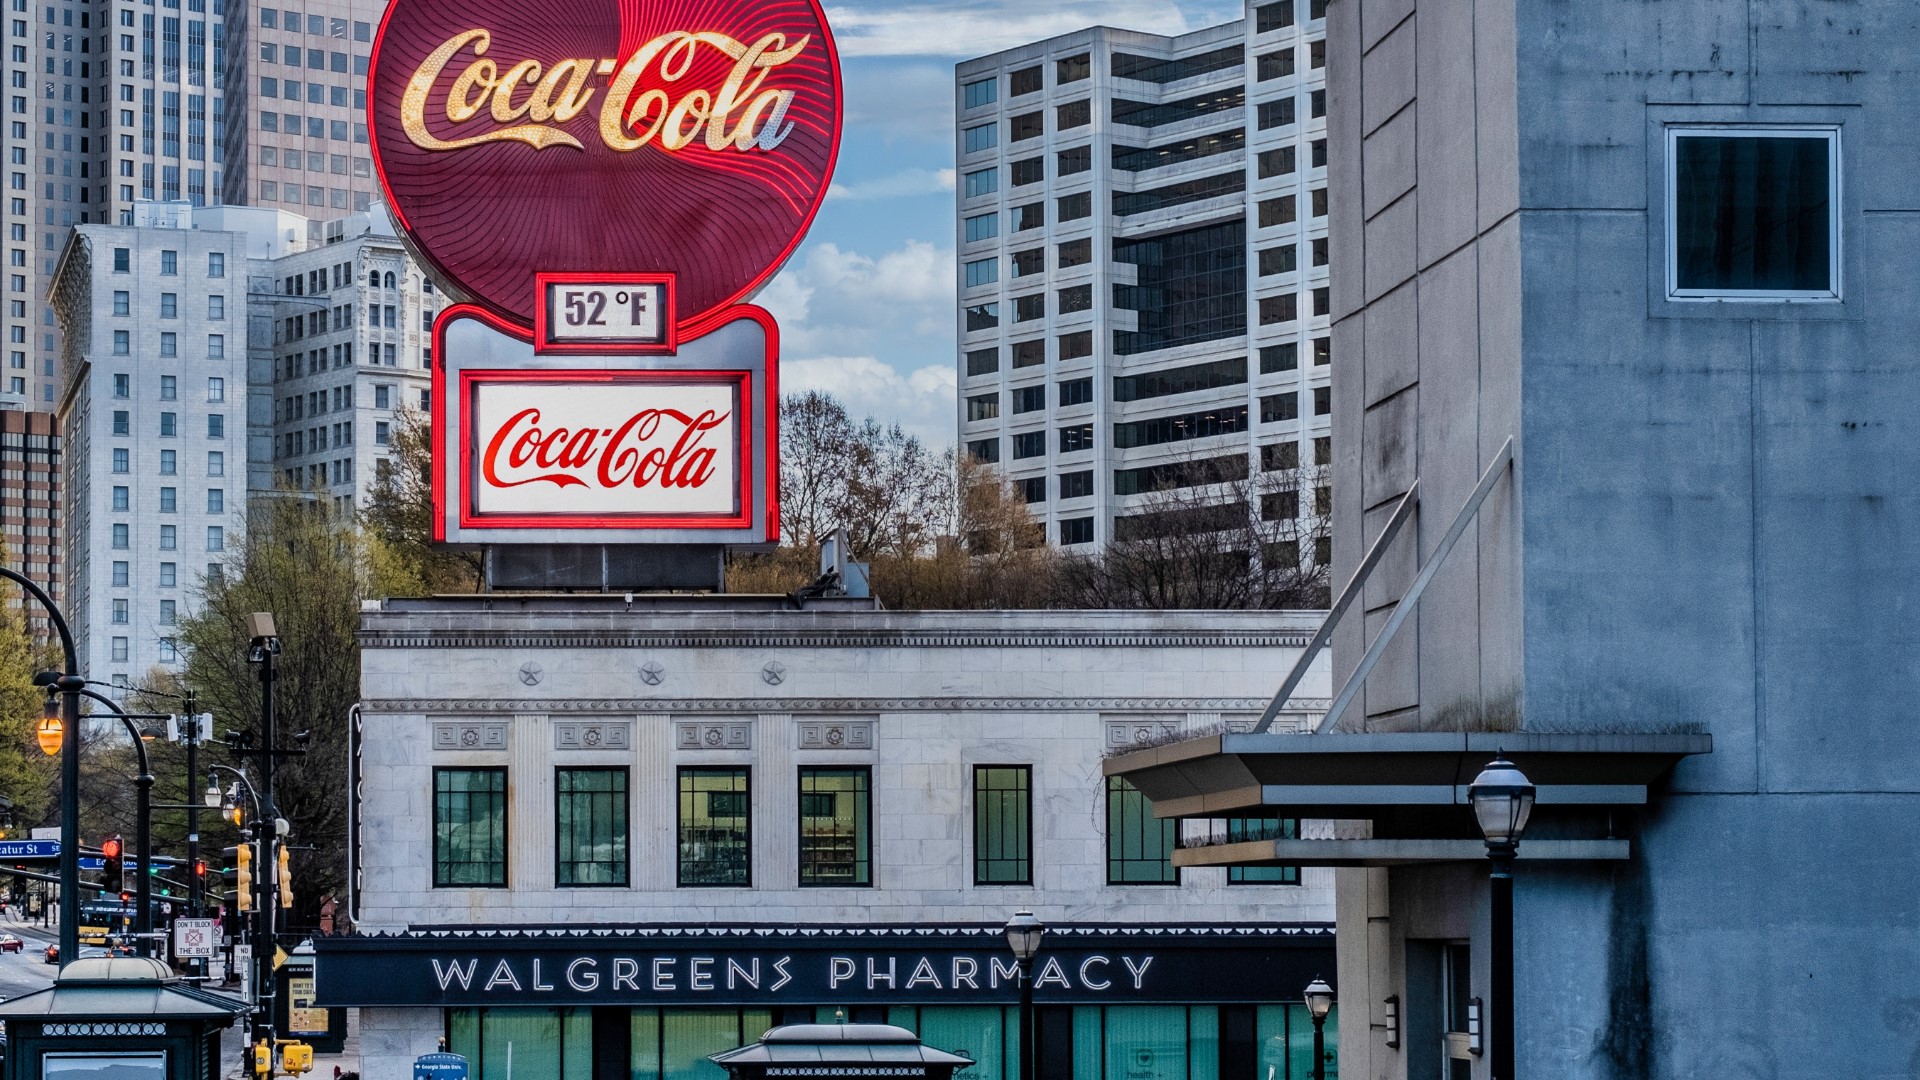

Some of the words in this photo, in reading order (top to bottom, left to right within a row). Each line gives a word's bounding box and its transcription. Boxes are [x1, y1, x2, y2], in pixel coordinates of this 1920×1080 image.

[400, 28, 811, 152] Coca-Cola
[565, 291, 607, 326] 52
[483, 408, 731, 489] Coca-Cola
[0, 844, 24, 855] atur
[26, 843, 38, 854] St
[431, 956, 792, 992] WALGREENS
[829, 955, 1154, 991] PHARMACY
[1127, 1070, 1154, 1079] health
